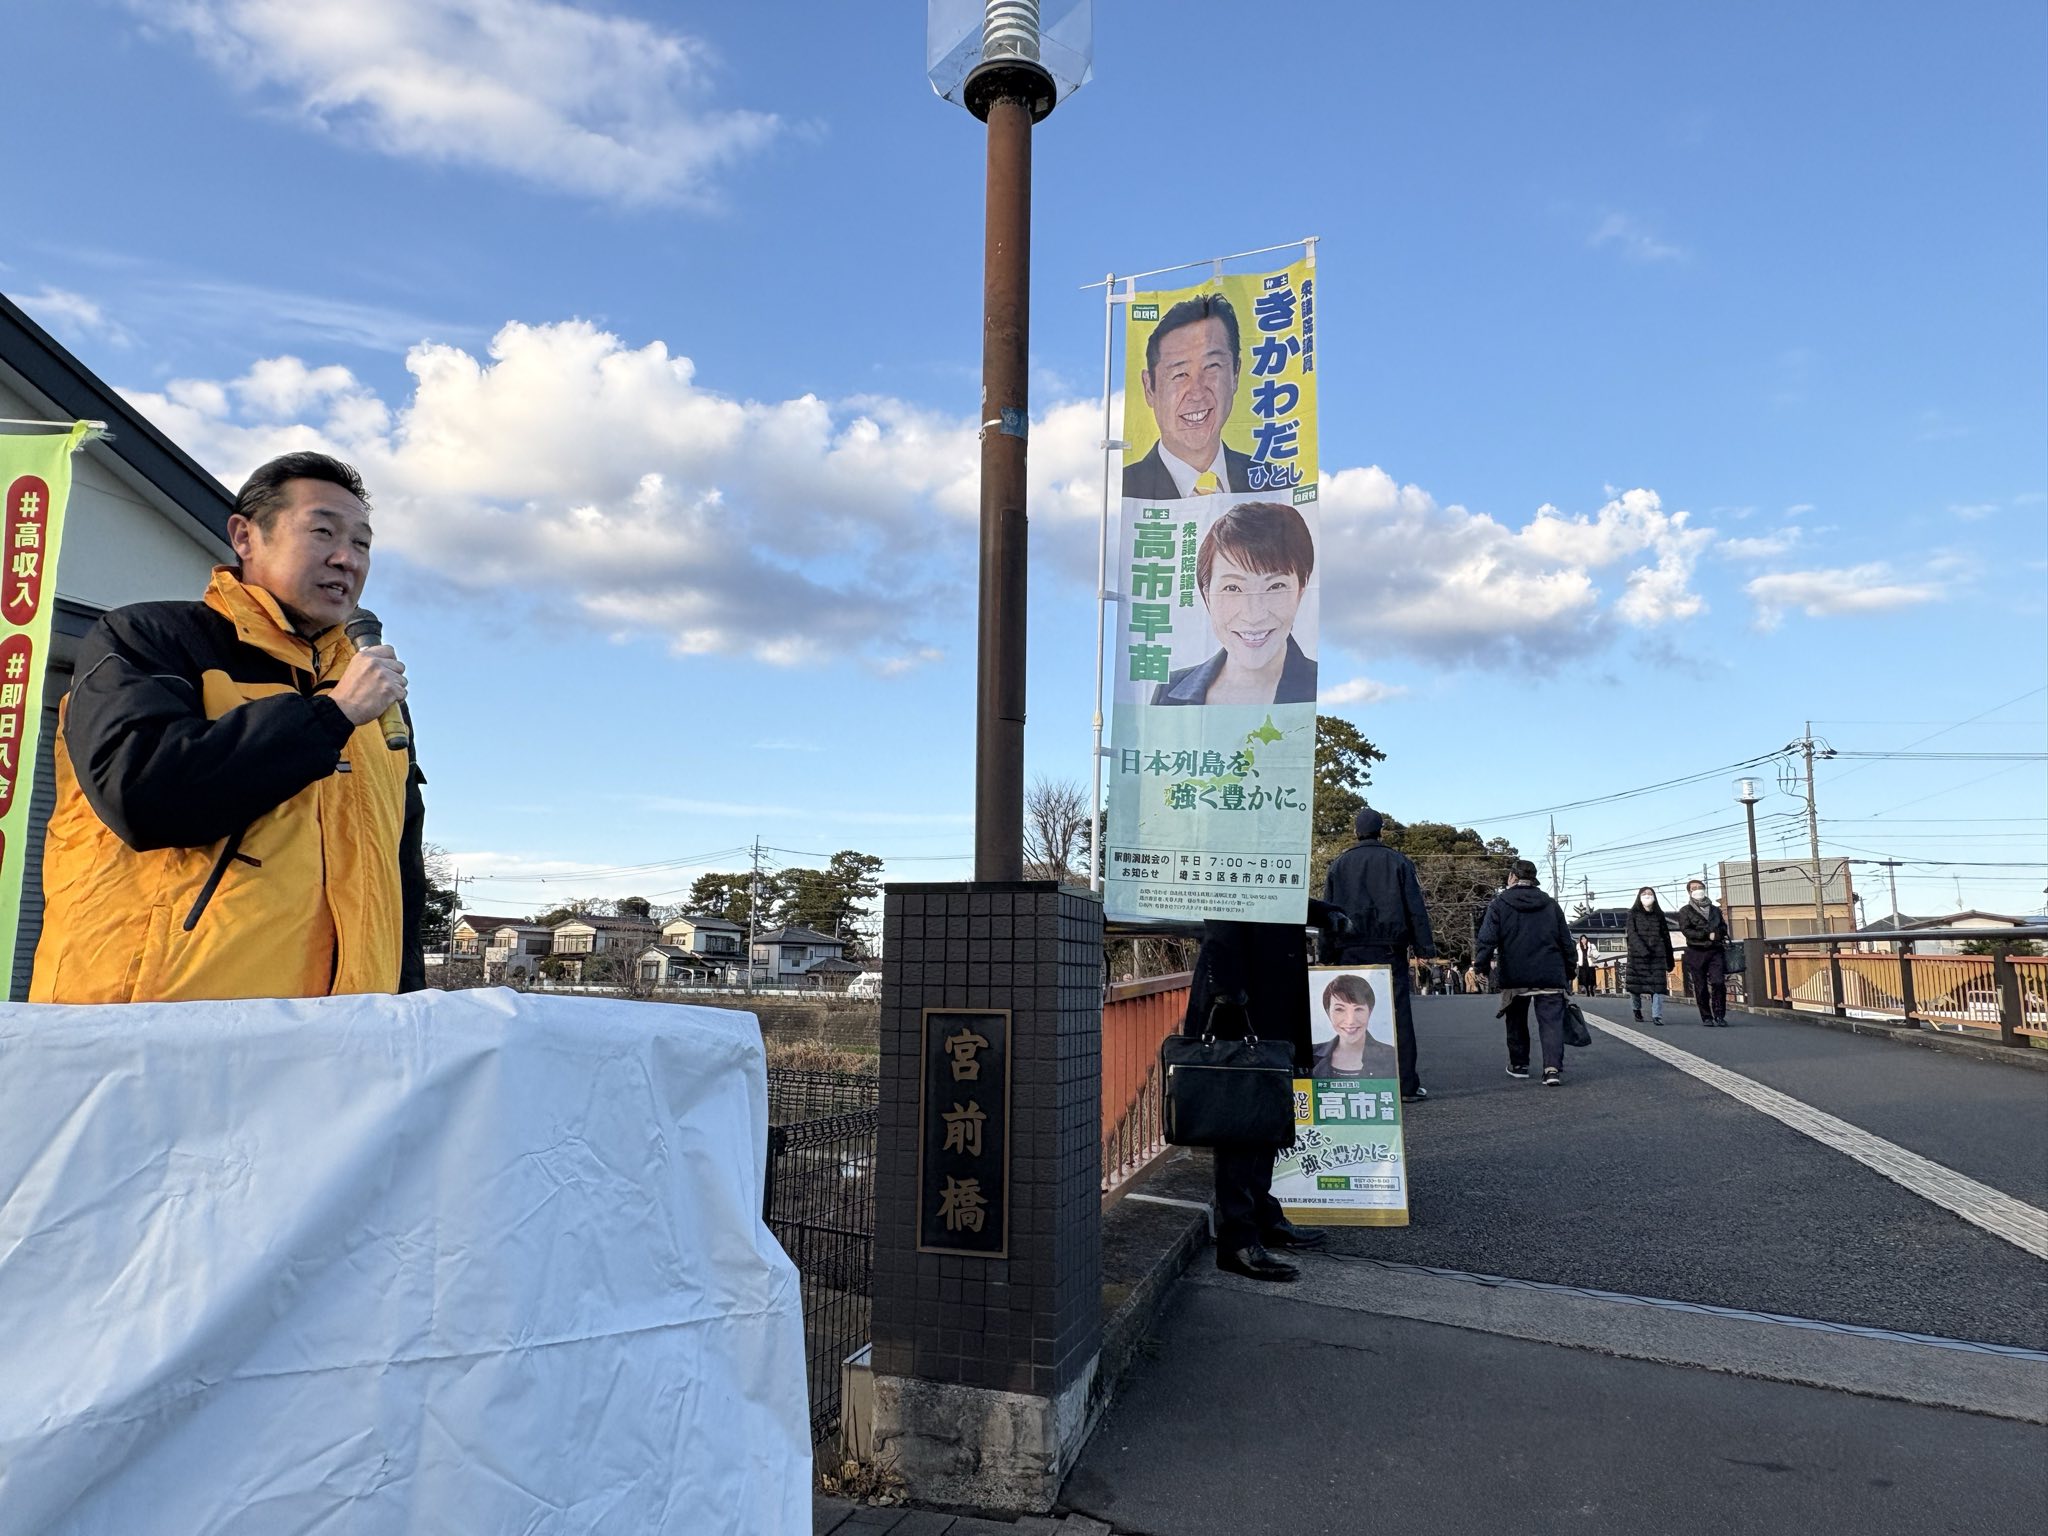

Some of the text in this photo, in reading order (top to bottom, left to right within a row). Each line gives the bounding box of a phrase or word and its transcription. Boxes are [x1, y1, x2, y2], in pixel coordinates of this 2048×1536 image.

[1251, 287, 1301, 463] きかわだ
[1248, 461, 1304, 490] ひとし
[9, 490, 41, 609] #高収入
[1179, 521, 1198, 608] 衆議院議員
[1128, 521, 1178, 684] 高市早苗
[1121, 748, 1260, 779] 日本列島を、
[1171, 782, 1307, 812] 強く豊かに。
[1122, 867, 1160, 879] お知らせ
[1180, 855, 1201, 866] 平日
[1317, 1092, 1377, 1119] 高市
[935, 1028, 990, 1233] 宮前橋
[1301, 1143, 1398, 1176] 強く豊かに。
